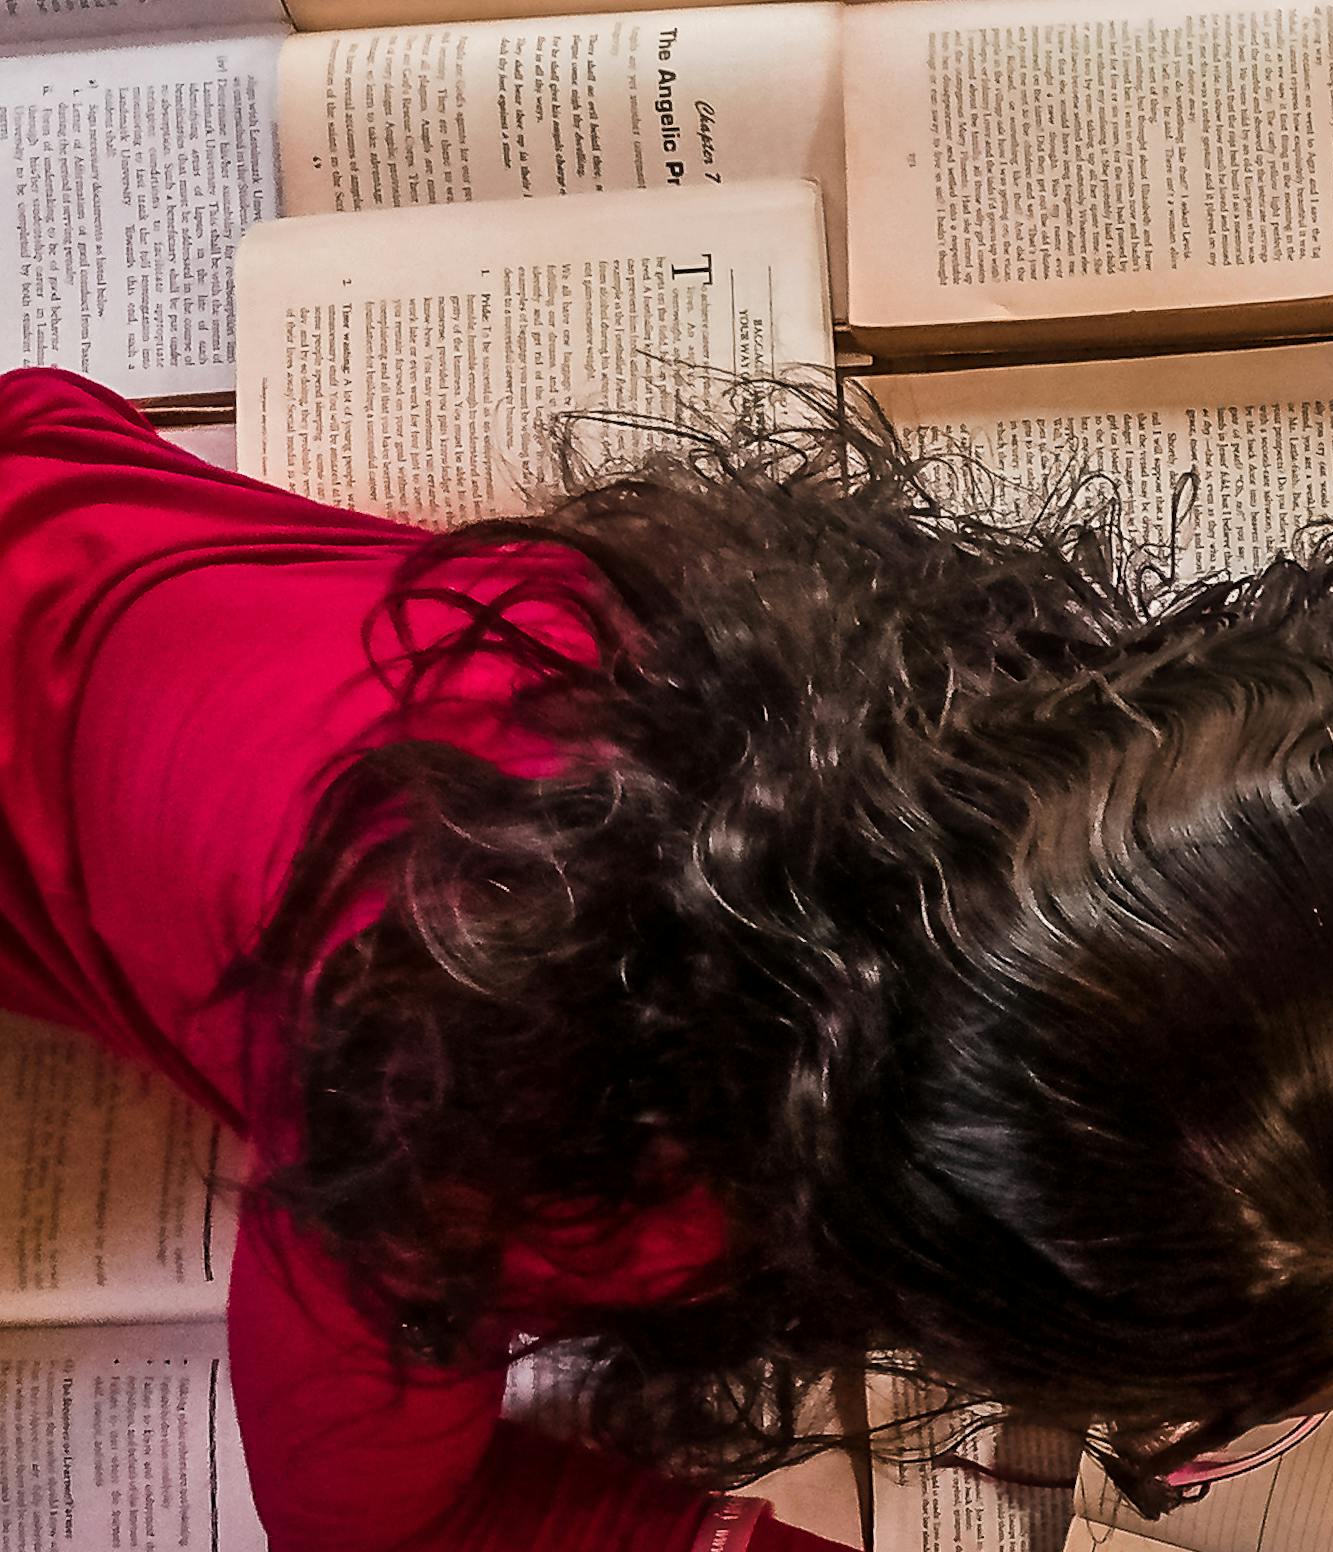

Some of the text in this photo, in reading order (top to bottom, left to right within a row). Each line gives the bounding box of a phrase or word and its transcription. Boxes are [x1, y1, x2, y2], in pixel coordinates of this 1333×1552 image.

[658, 27, 678, 61] The
[655, 68, 681, 152] Angelic
[695, 99, 721, 185] Chapter 7
[739, 343, 750, 369] WAY
